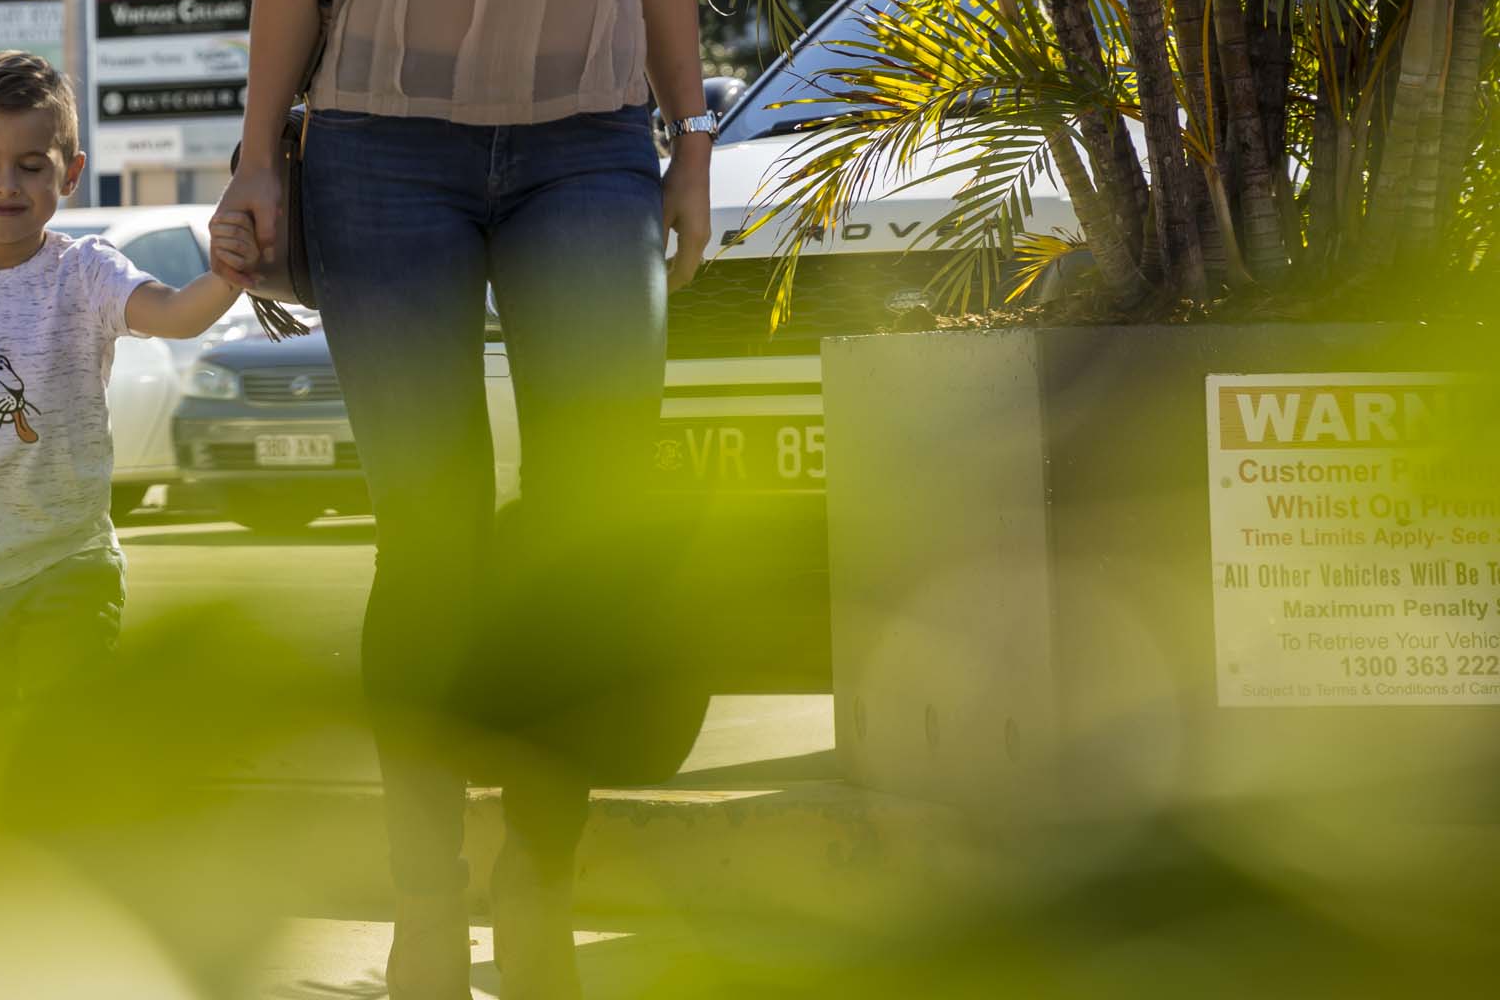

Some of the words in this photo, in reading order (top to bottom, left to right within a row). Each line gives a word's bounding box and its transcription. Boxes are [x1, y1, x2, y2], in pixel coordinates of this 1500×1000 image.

[804, 218, 1012, 243] ROVE
[684, 427, 748, 480] VR
[1237, 457, 1382, 484] Customer
[1266, 494, 1361, 520] Whilst
[1241, 527, 1294, 547] Time
[1300, 526, 1366, 546] Limits
[1451, 526, 1490, 545] See
[1223, 564, 1249, 589] All
[1258, 563, 1312, 588] Other
[1320, 561, 1402, 588] Vehicles
[1409, 560, 1448, 587] Will
[1455, 561, 1479, 586] Be
[1282, 599, 1396, 620] Maximum
[1403, 599, 1489, 621] Penalty
[1277, 632, 1301, 651] To
[1307, 632, 1389, 651] Retrieve
[1395, 631, 1439, 650] Your
[1340, 656, 1398, 677] 1300
[1405, 655, 1449, 677] 363
[1456, 654, 1500, 676] 222
[1315, 683, 1357, 697] Terms
[1361, 682, 1372, 696] &
[1375, 682, 1449, 696] Conditions
